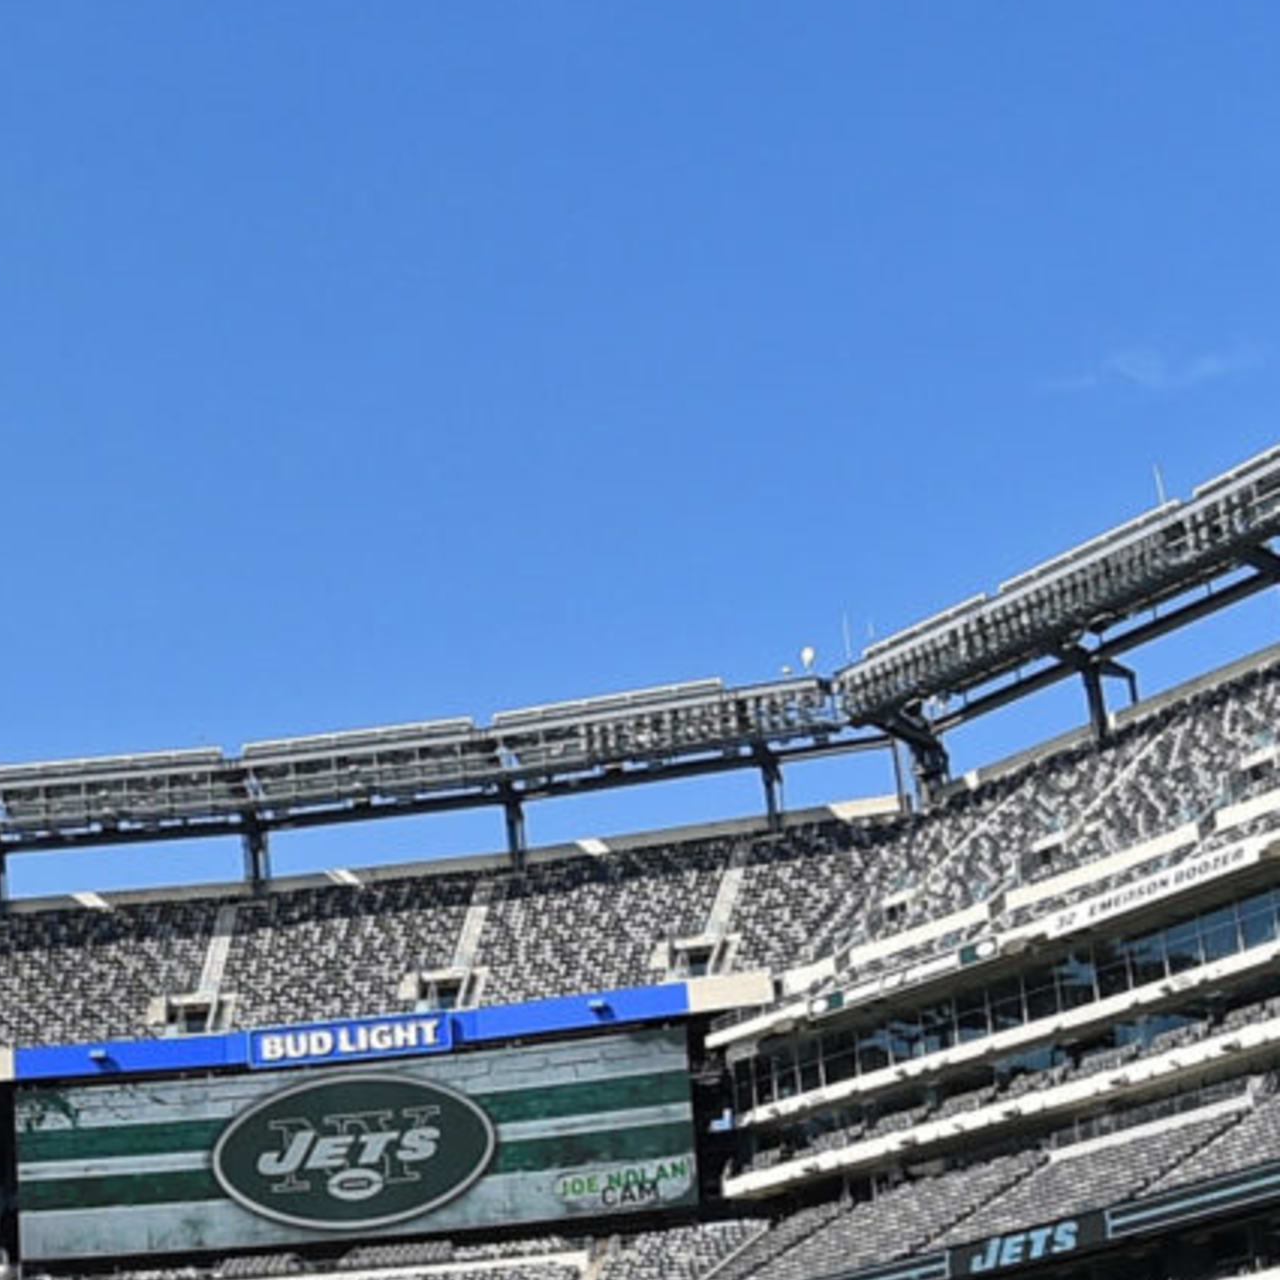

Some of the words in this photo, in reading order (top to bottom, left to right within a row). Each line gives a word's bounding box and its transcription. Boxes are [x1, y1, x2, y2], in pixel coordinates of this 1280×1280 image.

[1089, 878, 1170, 916] EMERSON
[1173, 847, 1246, 885] BOOZER
[261, 1030, 334, 1061] BUD
[339, 1020, 439, 1053] LIGHT
[257, 1126, 441, 1174] JETS
[562, 1176, 599, 1197] JOE
[606, 1160, 689, 1189] NOLAN
[601, 1183, 661, 1207] CAM
[970, 1220, 1080, 1273] JETS
